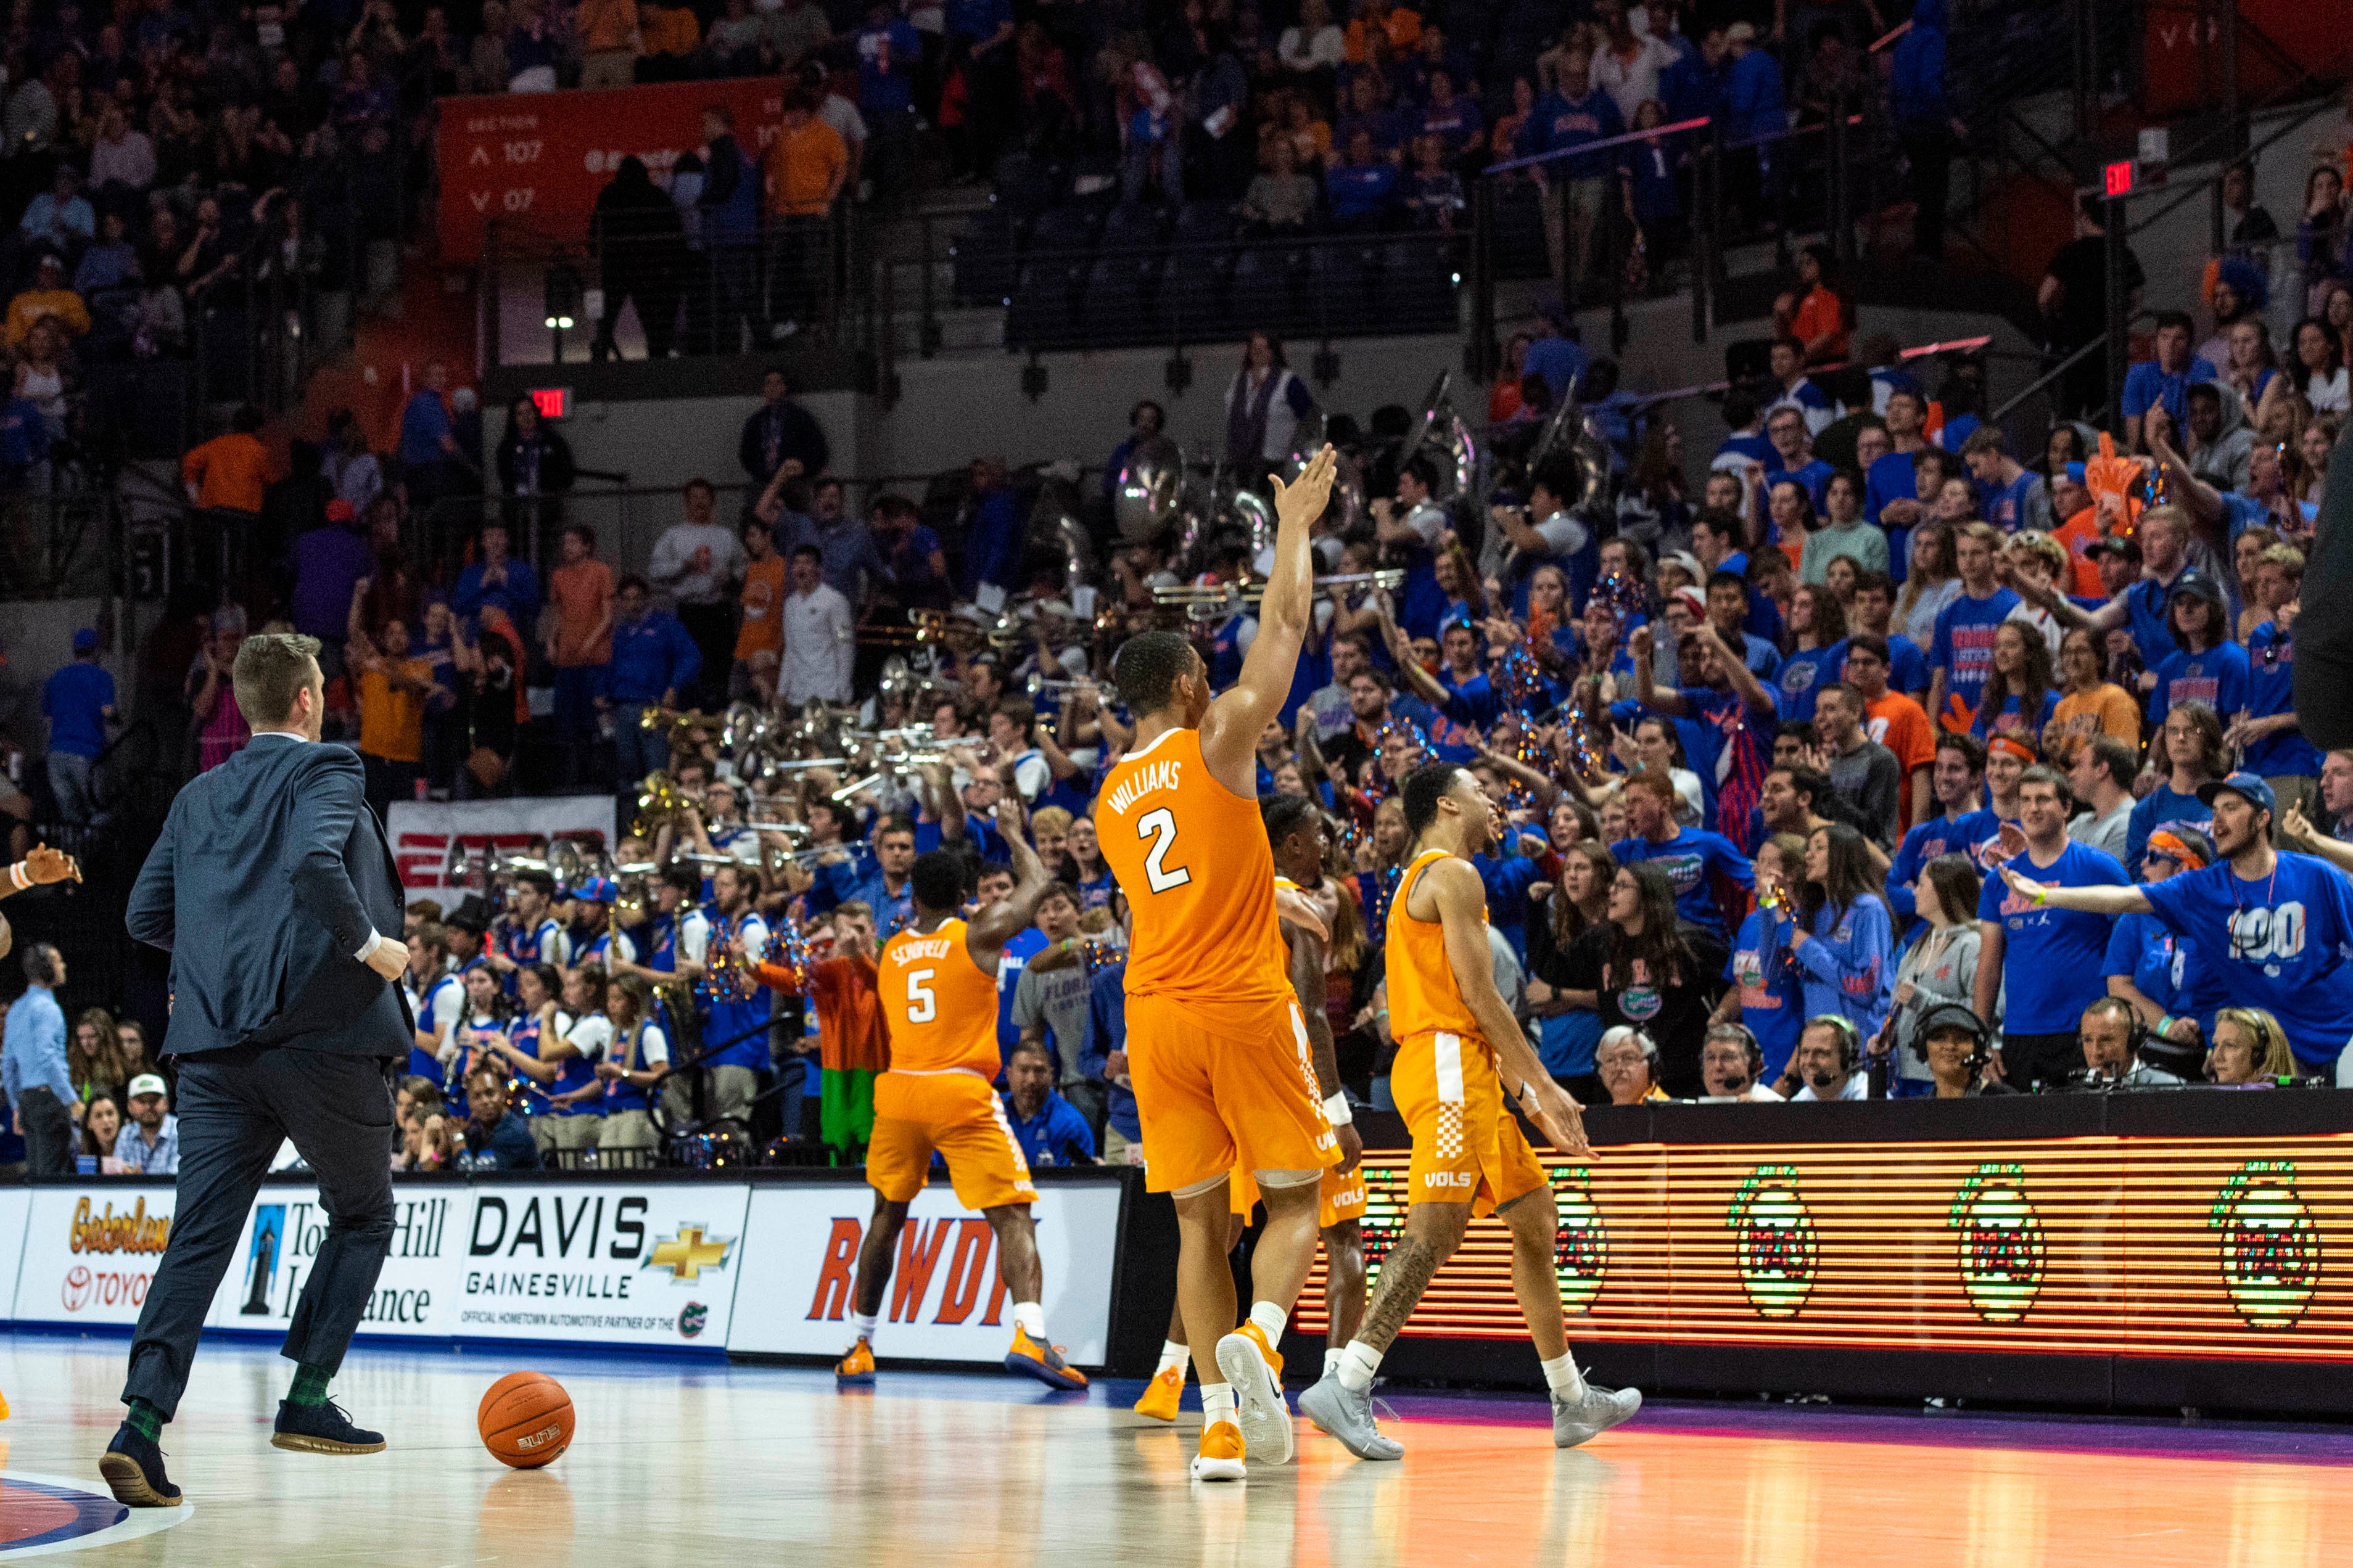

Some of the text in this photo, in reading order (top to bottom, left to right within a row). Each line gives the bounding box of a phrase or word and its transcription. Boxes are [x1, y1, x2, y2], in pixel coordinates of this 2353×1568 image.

[504, 139, 544, 163] 107
[504, 187, 535, 211] 07
[1106, 760, 1182, 816] WILLIAMS
[1136, 806, 1192, 895] 2
[891, 938, 951, 967] SCHOFIELD
[907, 968, 936, 1024] 5
[1425, 1171, 1472, 1188] VOLS
[1333, 1186, 1364, 1209] VOLS
[70, 1195, 172, 1256] Gatorlan
[469, 1196, 648, 1259] DAVIS
[466, 1272, 632, 1299] GAINESVILLE
[804, 1217, 1042, 1326] RWD
[94, 1273, 155, 1307] TOYO
[281, 1265, 431, 1323] Iance
[461, 1311, 676, 1331] OFFICIAL HOMETOWN AUTOMOTIVE PARTNER OF THE
